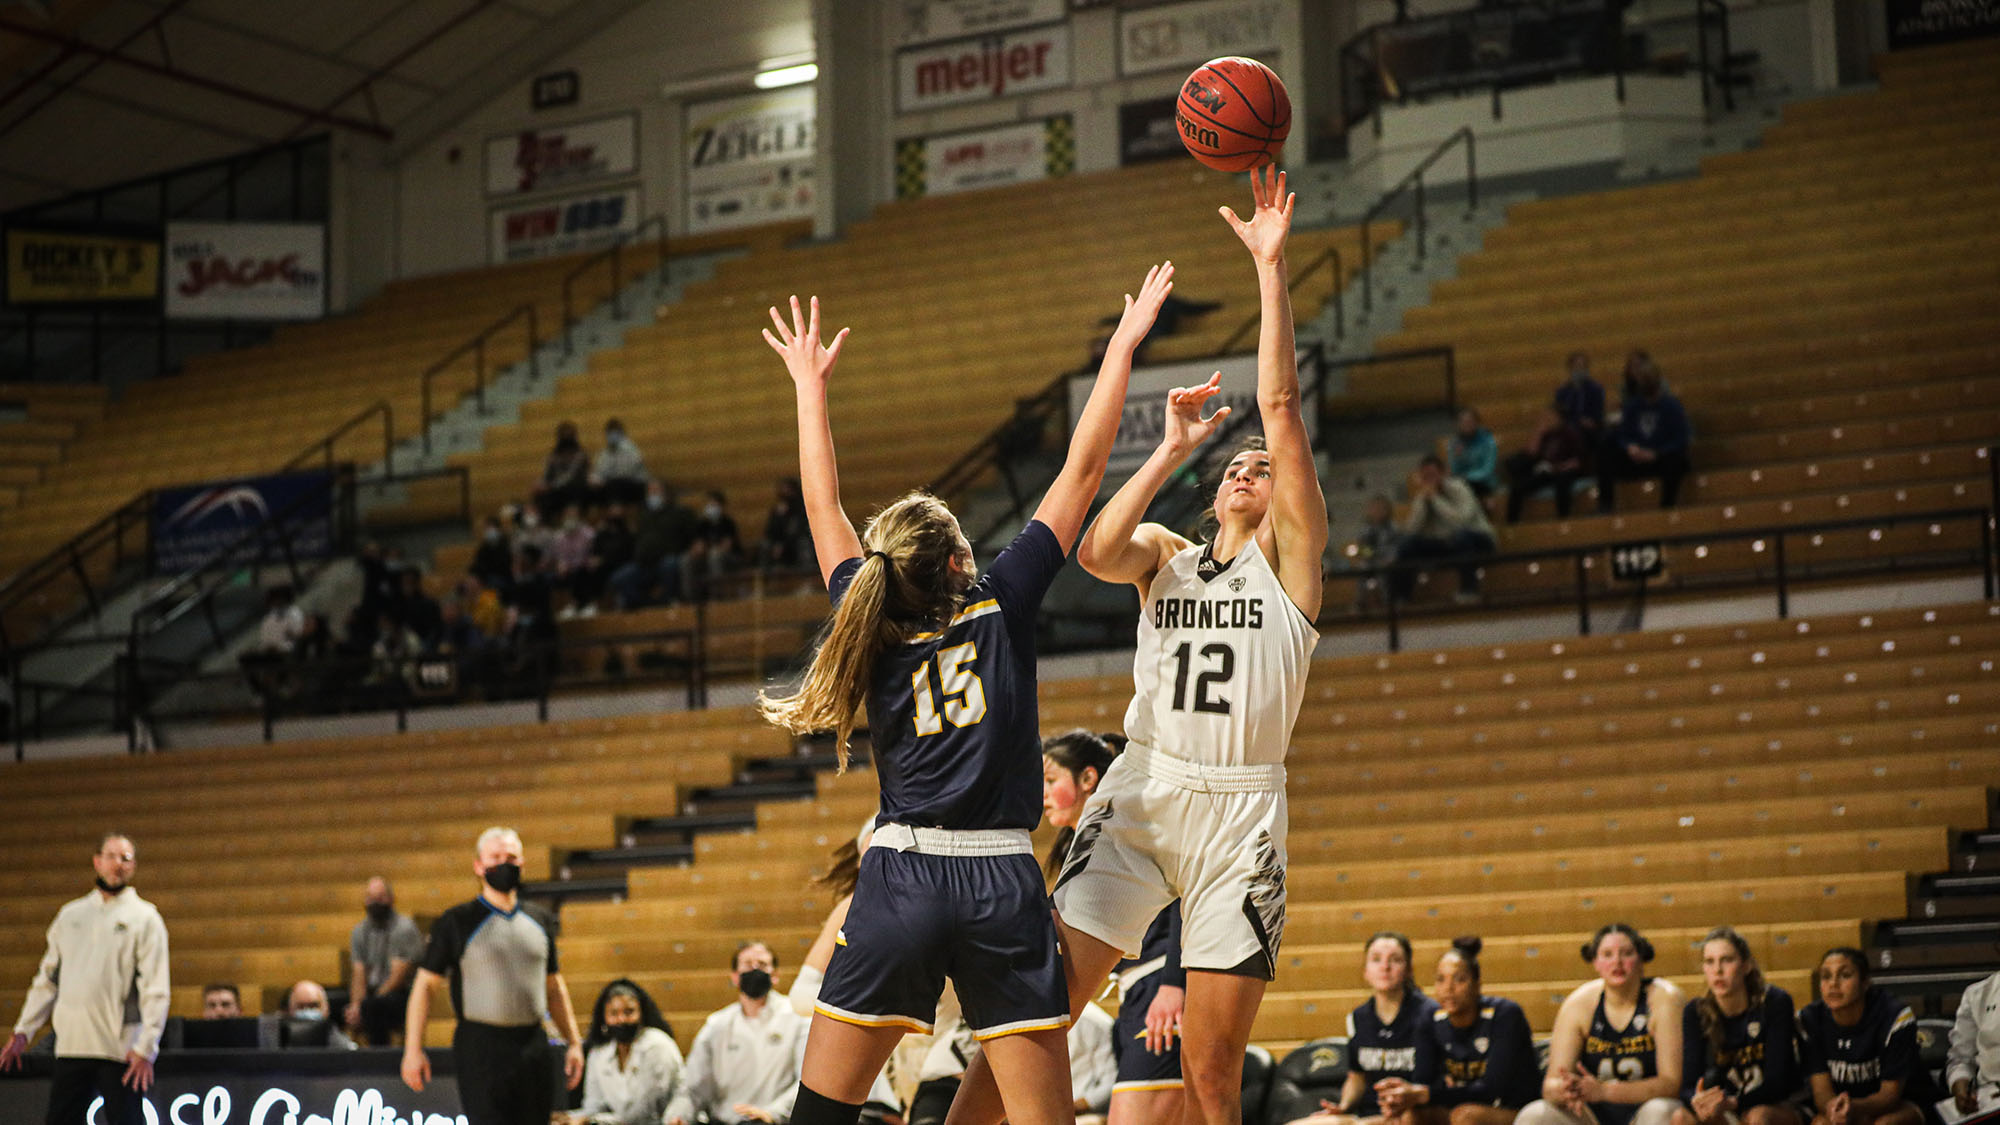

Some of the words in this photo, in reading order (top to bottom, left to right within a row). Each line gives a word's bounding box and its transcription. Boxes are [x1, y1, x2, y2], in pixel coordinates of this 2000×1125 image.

[916, 36, 1052, 96] meijer
[693, 121, 817, 167] ZEIGLE
[23, 244, 143, 272] DICKEYS
[1155, 598, 1263, 630] BRONCOS
[912, 640, 986, 737] 15
[1171, 640, 1235, 716] 12
